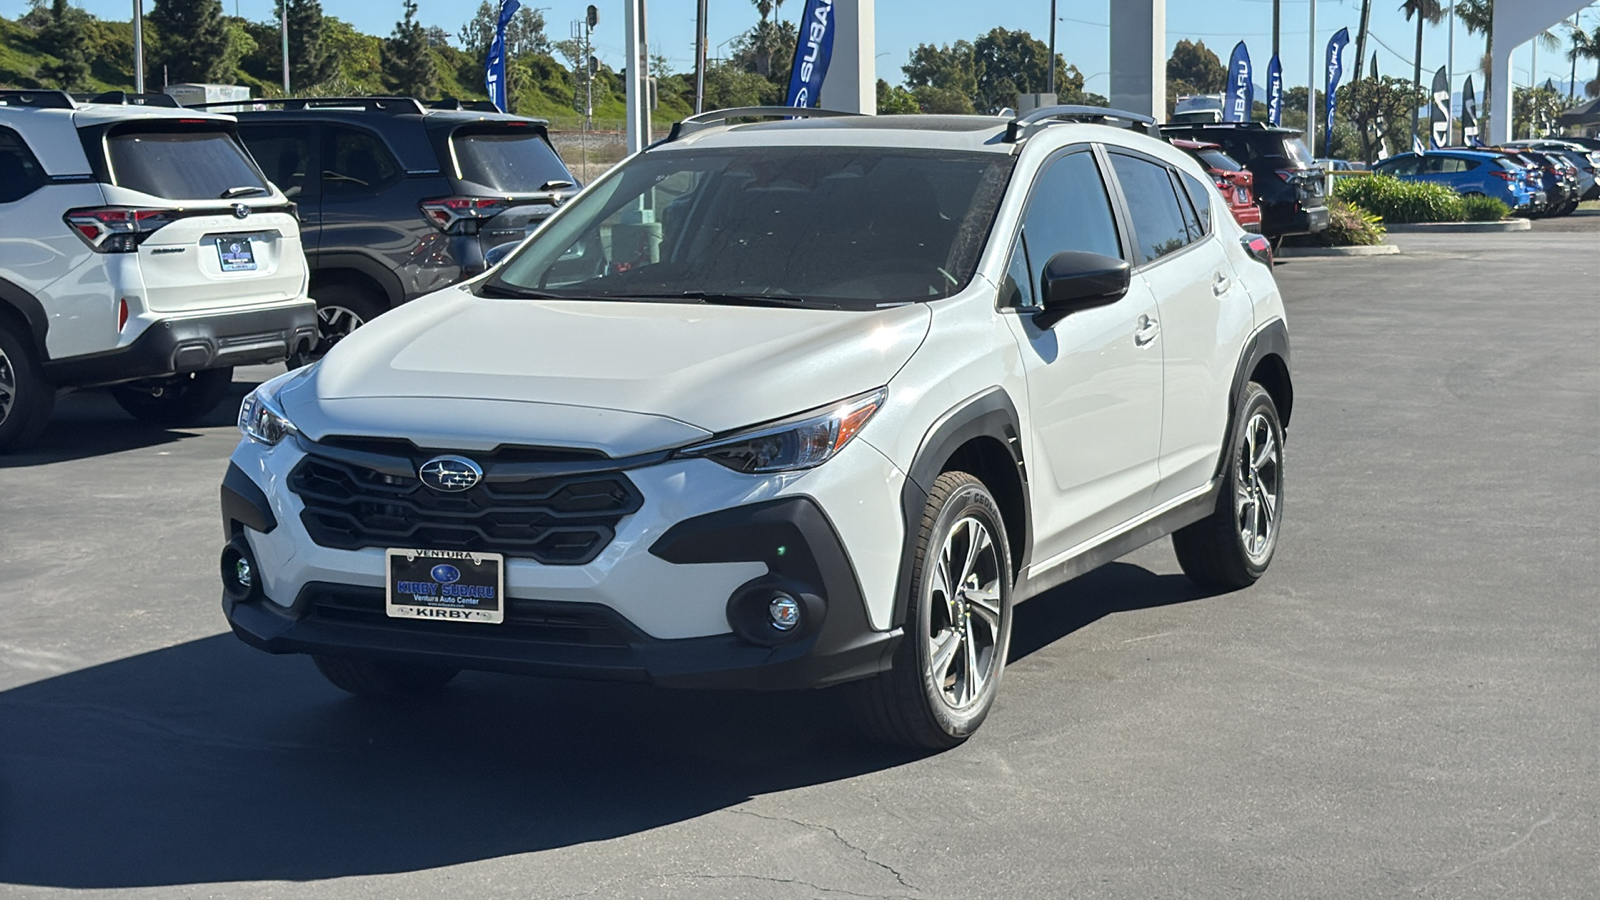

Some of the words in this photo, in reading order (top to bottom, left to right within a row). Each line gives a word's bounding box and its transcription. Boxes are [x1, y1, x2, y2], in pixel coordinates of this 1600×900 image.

[1233, 61, 1248, 123] UBARU
[416, 550, 473, 559] VENTURA
[398, 581, 438, 595] KIRBY
[442, 584, 494, 598] SUBARU
[413, 594, 438, 602] Ventura
[457, 597, 479, 605] Center
[416, 608, 473, 619] KIRBY
